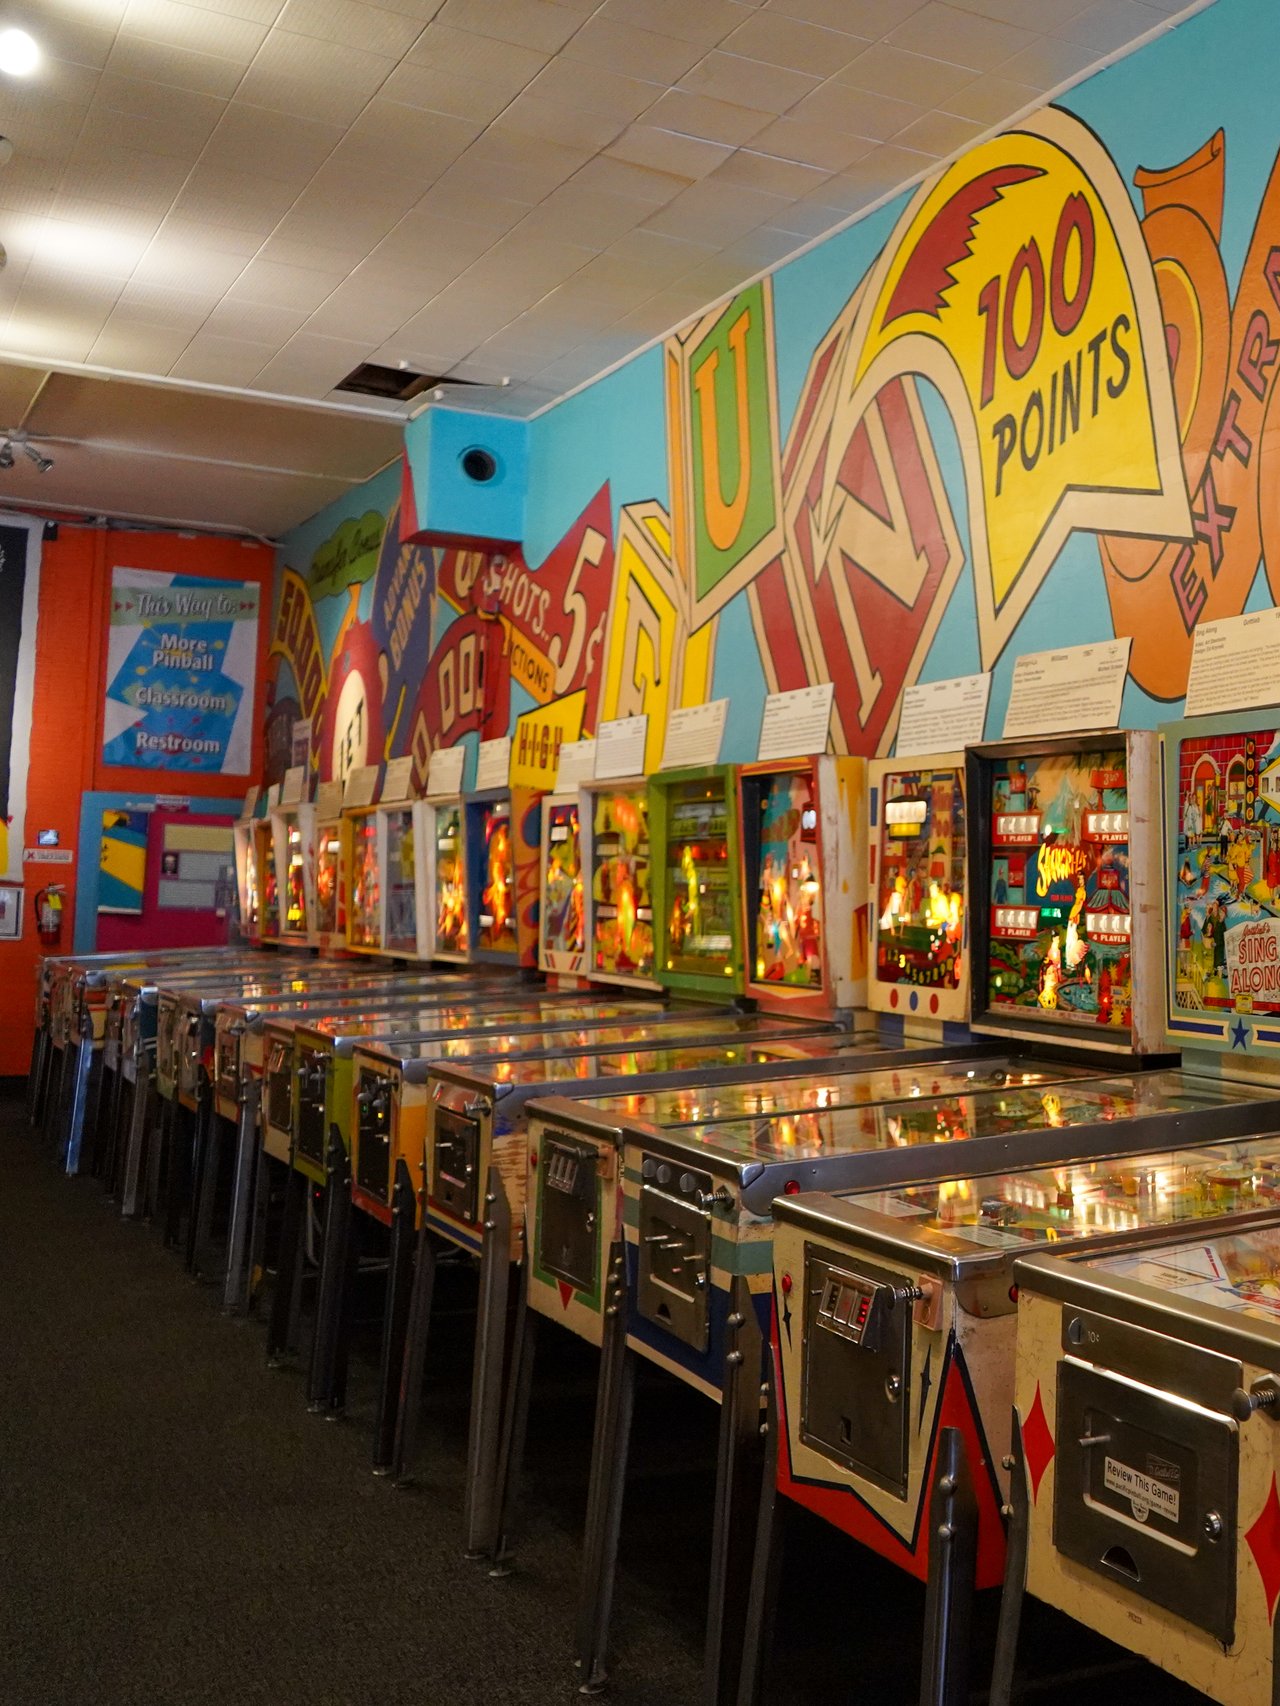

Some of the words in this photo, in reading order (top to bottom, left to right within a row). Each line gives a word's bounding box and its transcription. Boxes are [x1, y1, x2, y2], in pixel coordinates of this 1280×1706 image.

[977, 190, 1096, 411] 100
[991, 314, 1132, 498] POINTS
[137, 593, 171, 617] This
[175, 591, 212, 619] Way
[160, 632, 208, 652] More
[152, 650, 214, 671] Pinball
[135, 687, 227, 710] Classroom
[136, 731, 221, 754] Restroom
[1100, 934, 1127, 943] PLAYER
[1238, 936, 1278, 964] SING
[1107, 1460, 1132, 1483] Review
[1134, 1474, 1149, 1492] This
[1152, 1483, 1176, 1506] Game!
